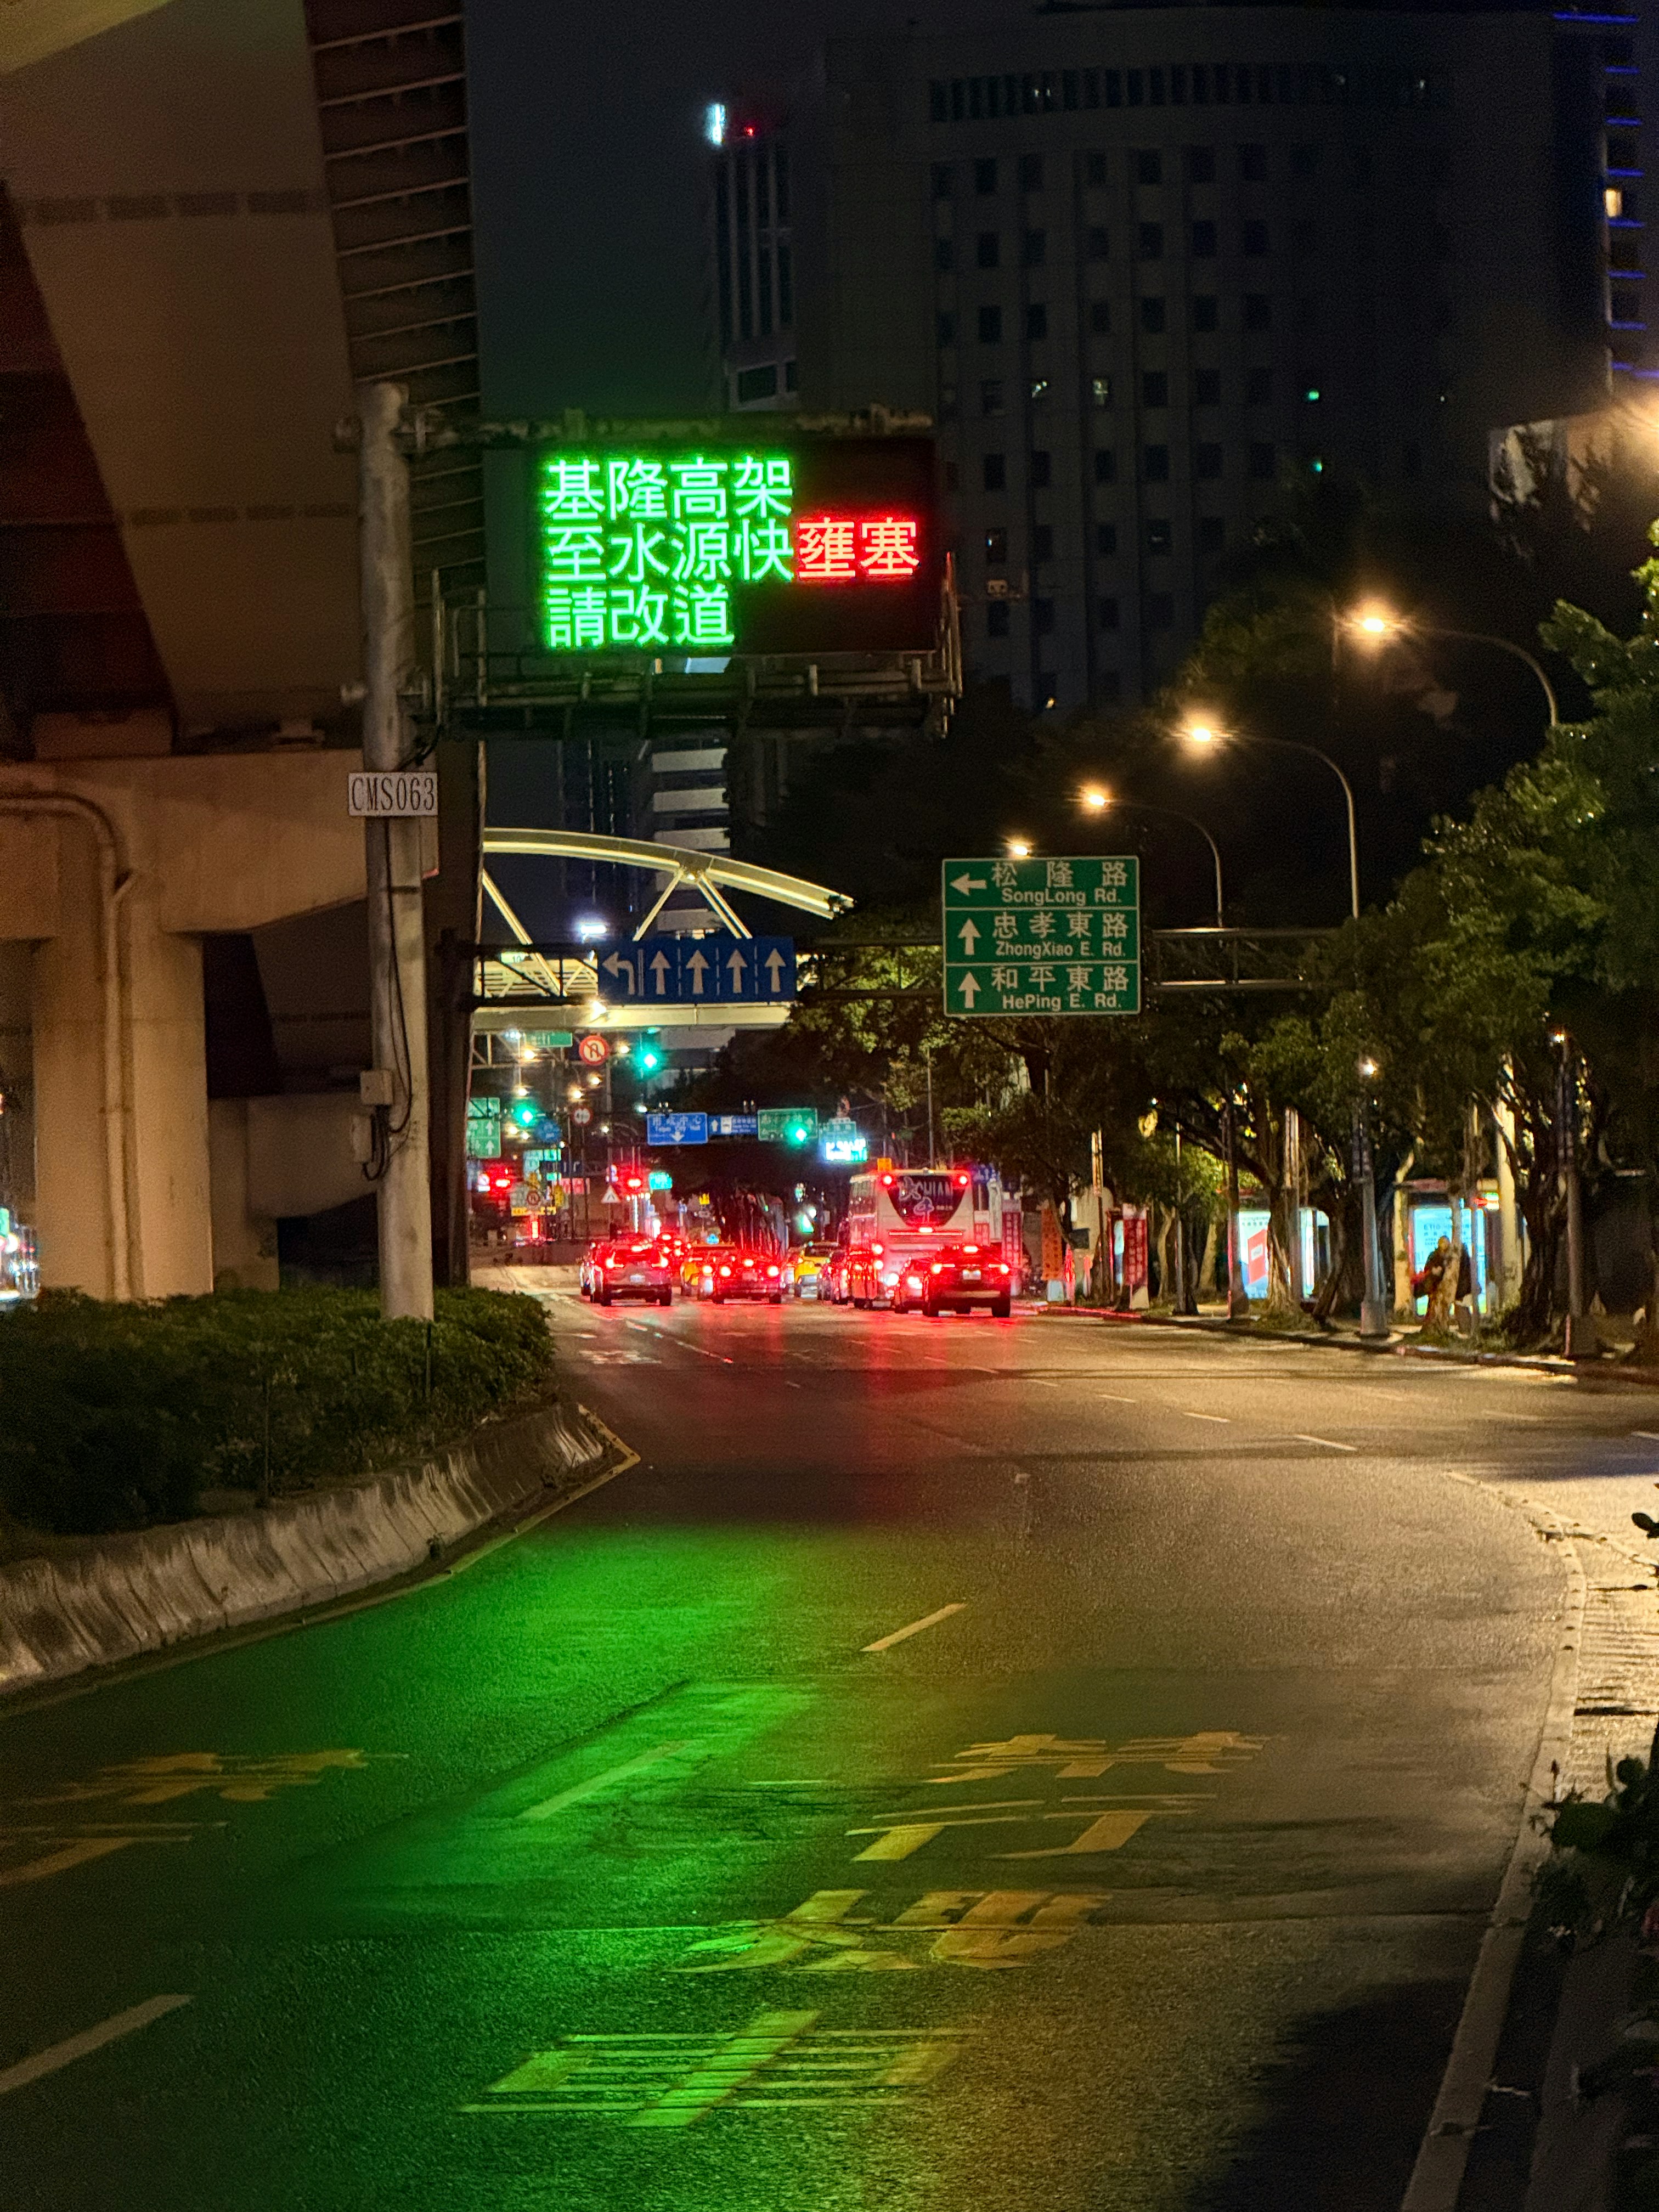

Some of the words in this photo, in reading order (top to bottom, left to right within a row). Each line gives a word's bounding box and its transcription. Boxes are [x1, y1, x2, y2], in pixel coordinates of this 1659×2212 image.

[544, 456, 794, 520] 基隆高架
[544, 583, 735, 648] 請改道
[352, 777, 435, 811] CMS063
[991, 860, 1128, 888] 松隆路
[1001, 887, 1086, 907] SongLong
[1094, 887, 1122, 903] Rd.
[992, 911, 1128, 939] 忠孝東路
[995, 940, 1074, 960] ZhongXiao
[1102, 940, 1126, 957] Rd.
[991, 965, 1129, 992] 和平東路
[1002, 994, 1062, 1012] HePing
[1094, 992, 1122, 1009] Rd.
